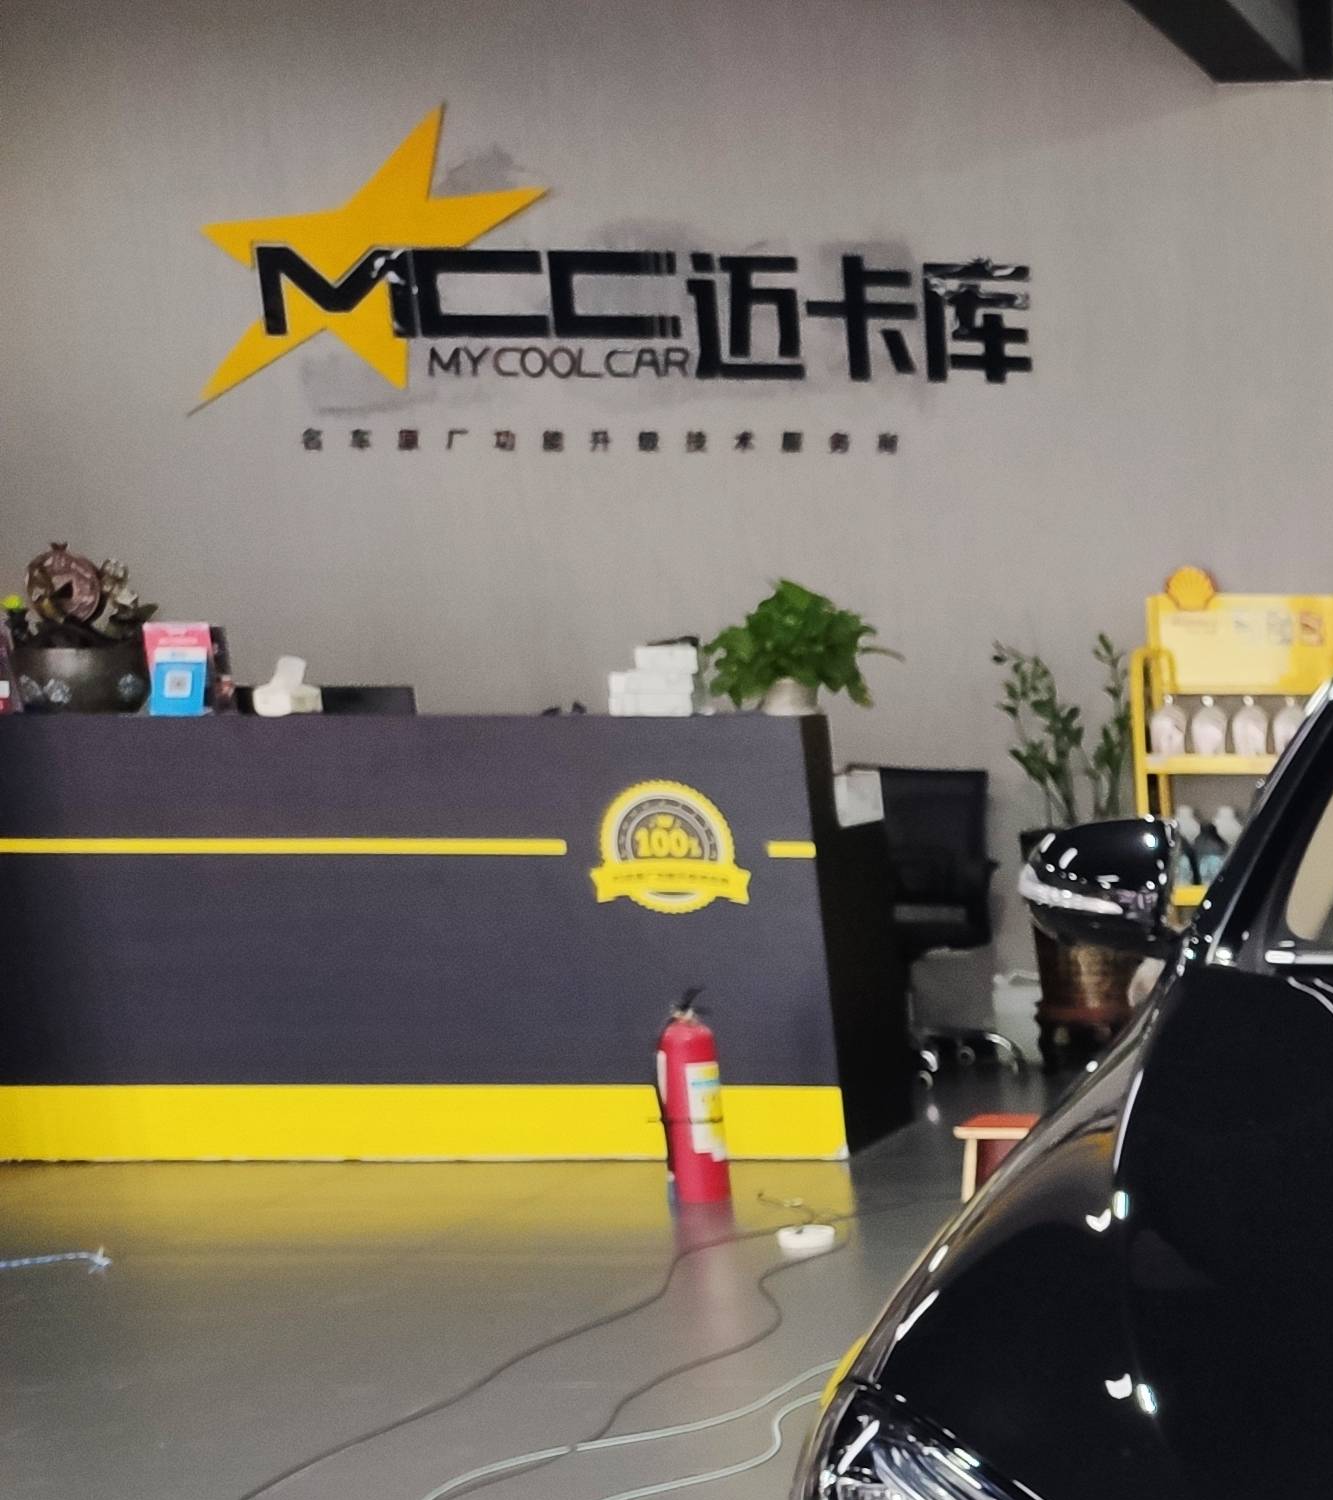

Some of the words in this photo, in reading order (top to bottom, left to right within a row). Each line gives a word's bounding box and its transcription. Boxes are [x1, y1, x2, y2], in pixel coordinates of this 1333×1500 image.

[687, 252, 1034, 384] 迈卡库
[427, 346, 691, 380] MYCOOLCAR
